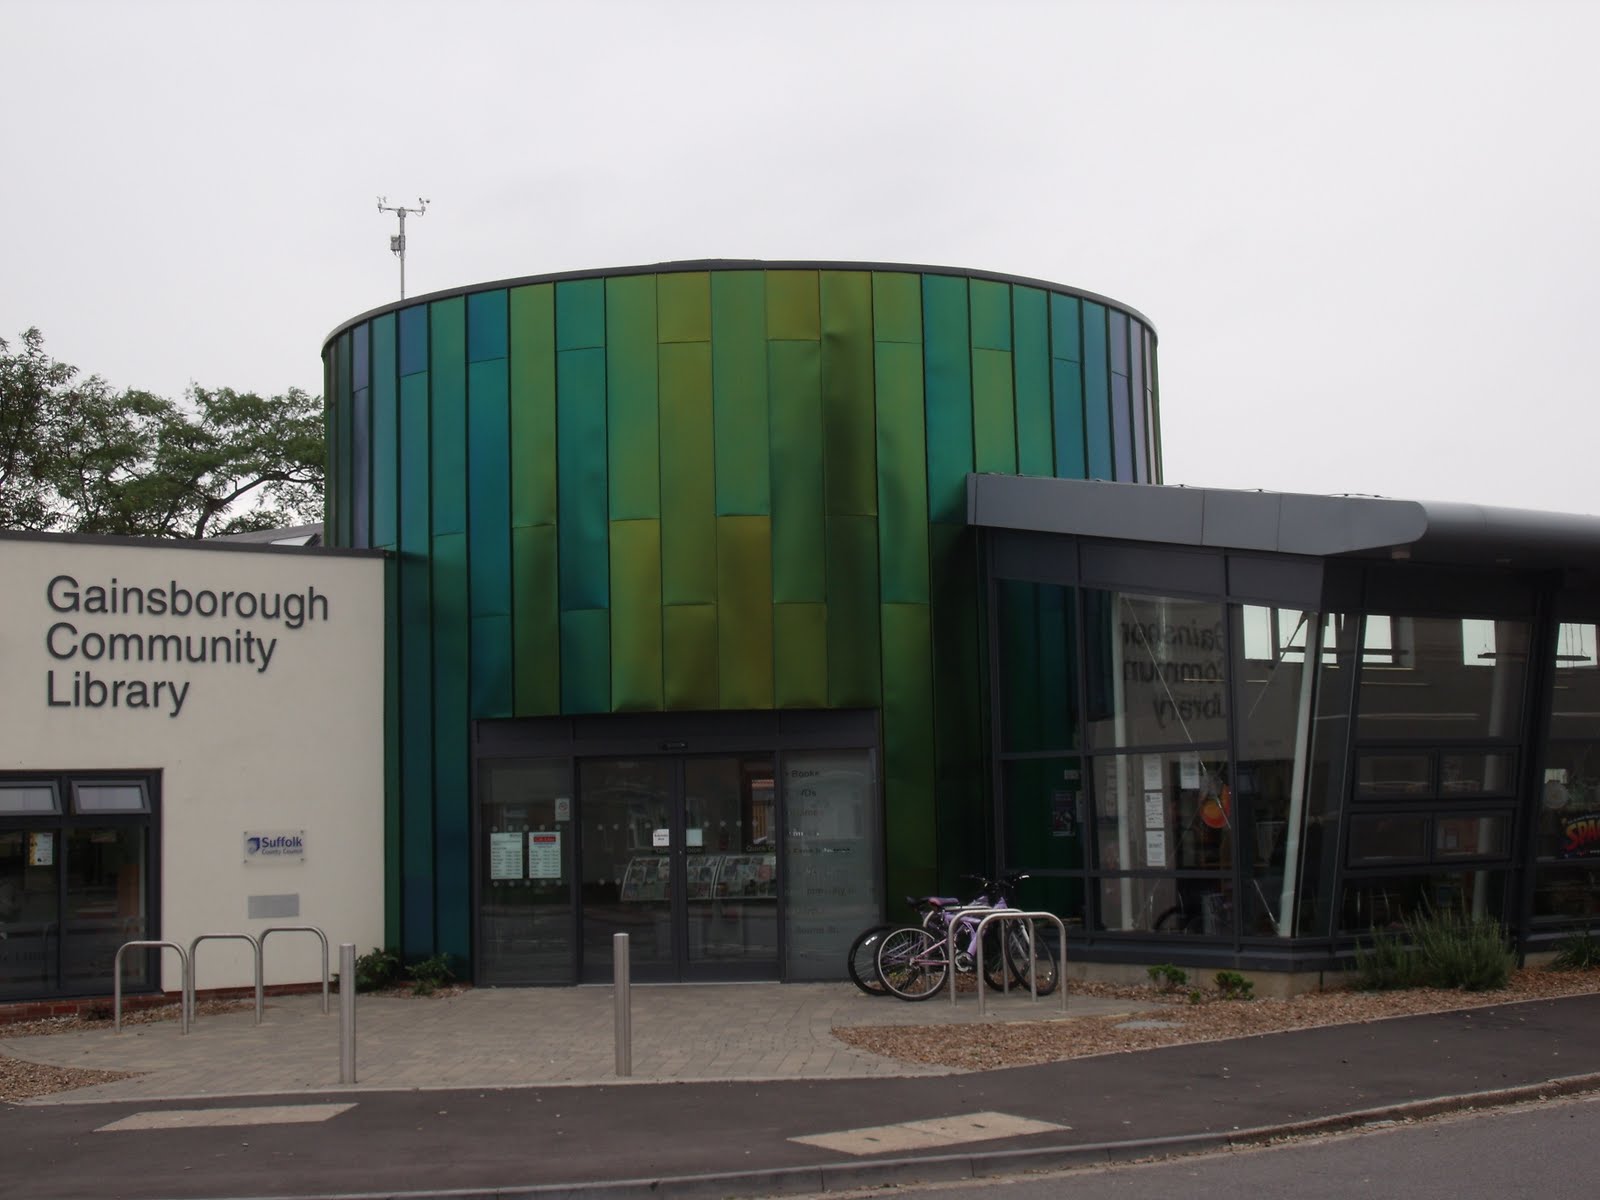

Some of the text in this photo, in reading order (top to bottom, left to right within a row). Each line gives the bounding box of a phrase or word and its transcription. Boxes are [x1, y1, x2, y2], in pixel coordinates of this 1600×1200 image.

[46, 574, 329, 629] Gainsborough
[46, 621, 277, 673] Community
[47, 669, 190, 718] Library
[262, 836, 302, 847] Suffolk
[1565, 819, 1600, 852] SPA
